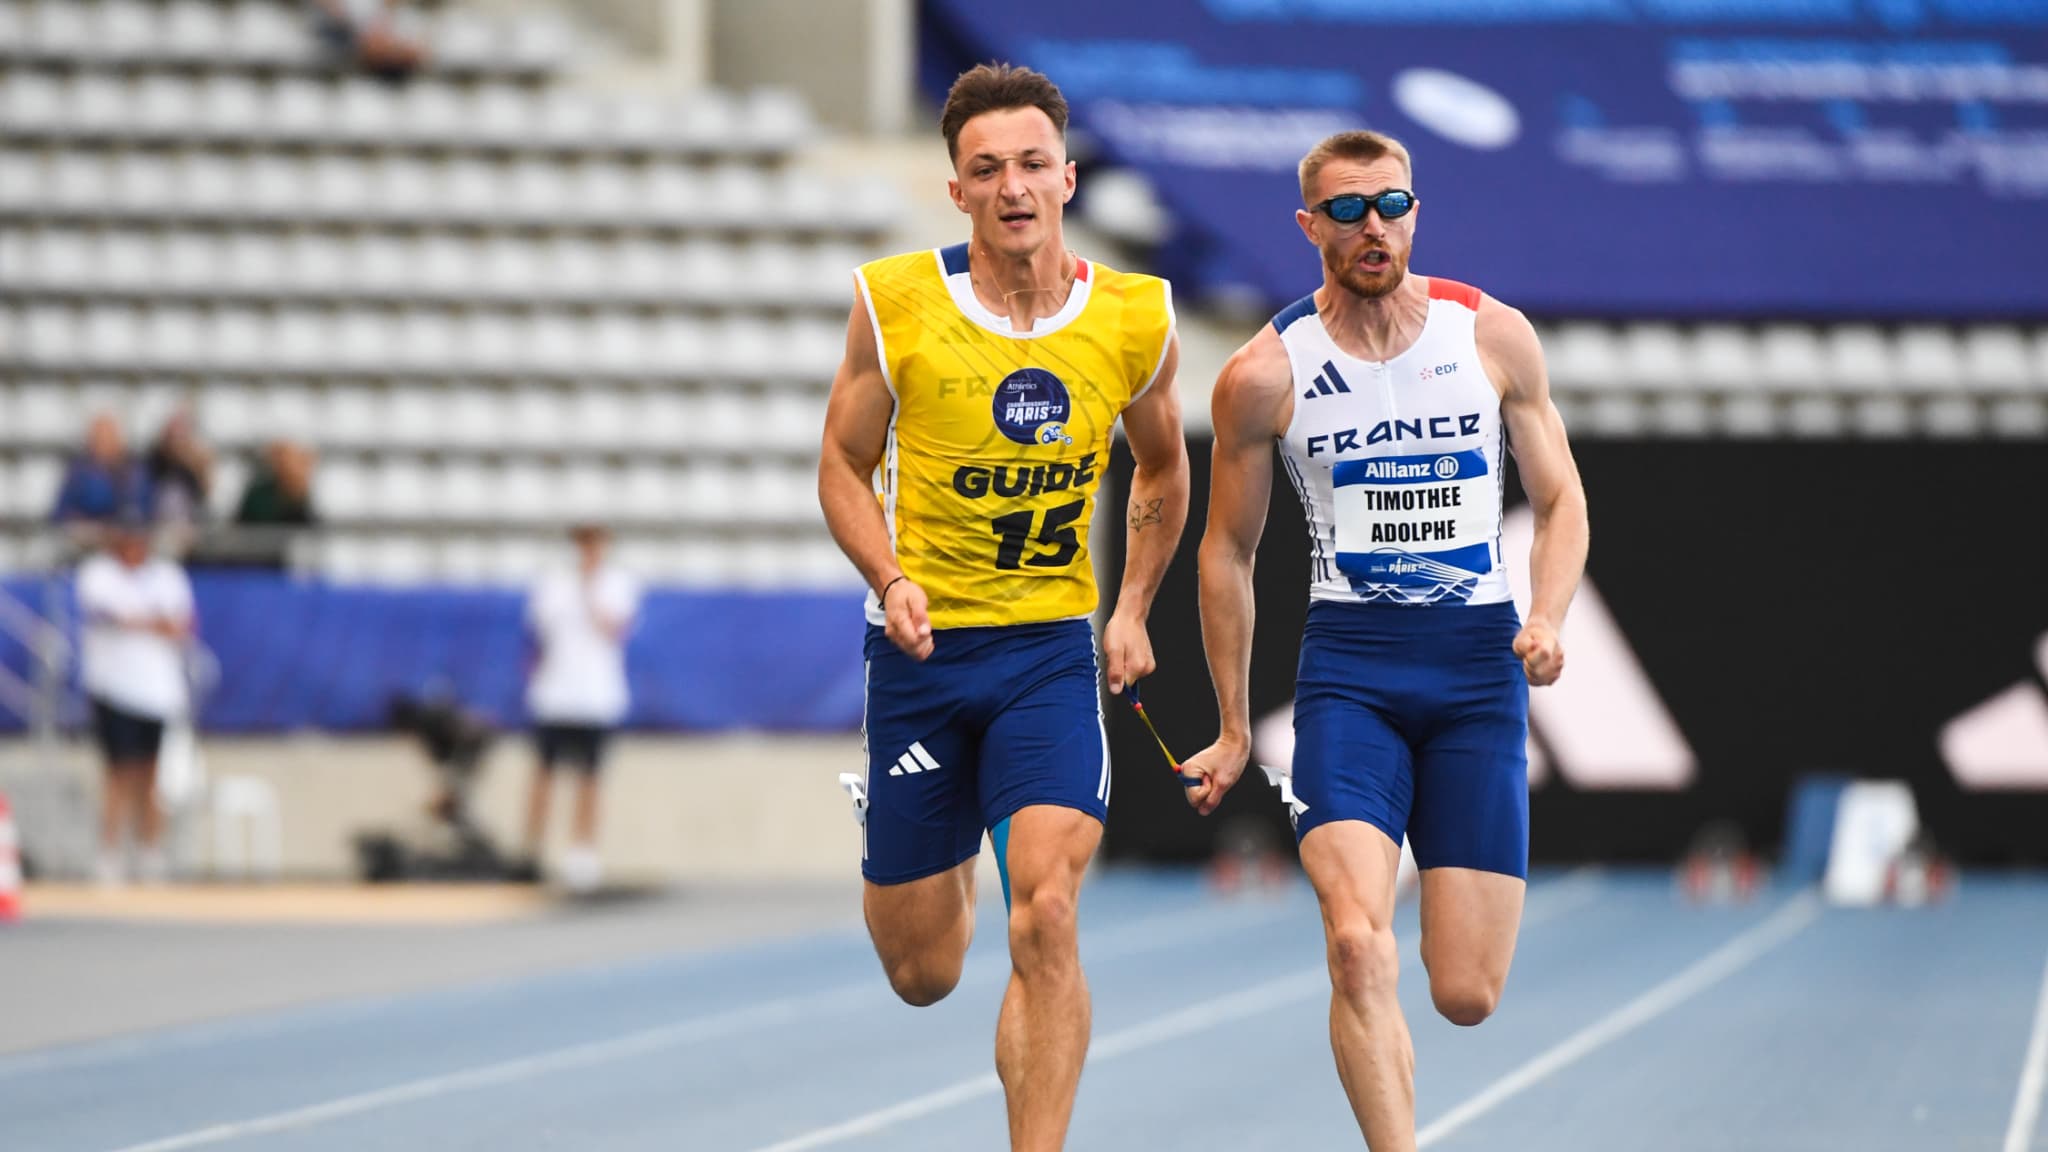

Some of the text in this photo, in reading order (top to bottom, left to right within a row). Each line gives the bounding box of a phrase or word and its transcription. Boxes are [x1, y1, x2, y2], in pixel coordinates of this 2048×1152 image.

[1307, 412, 1481, 459] FRANCE
[953, 451, 1098, 499] GUIDE
[1364, 461, 1432, 479] Allianz
[1363, 485, 1462, 512] TIMOTHEE
[991, 498, 1086, 570] 15
[1370, 519, 1456, 543] ADOLPHE
